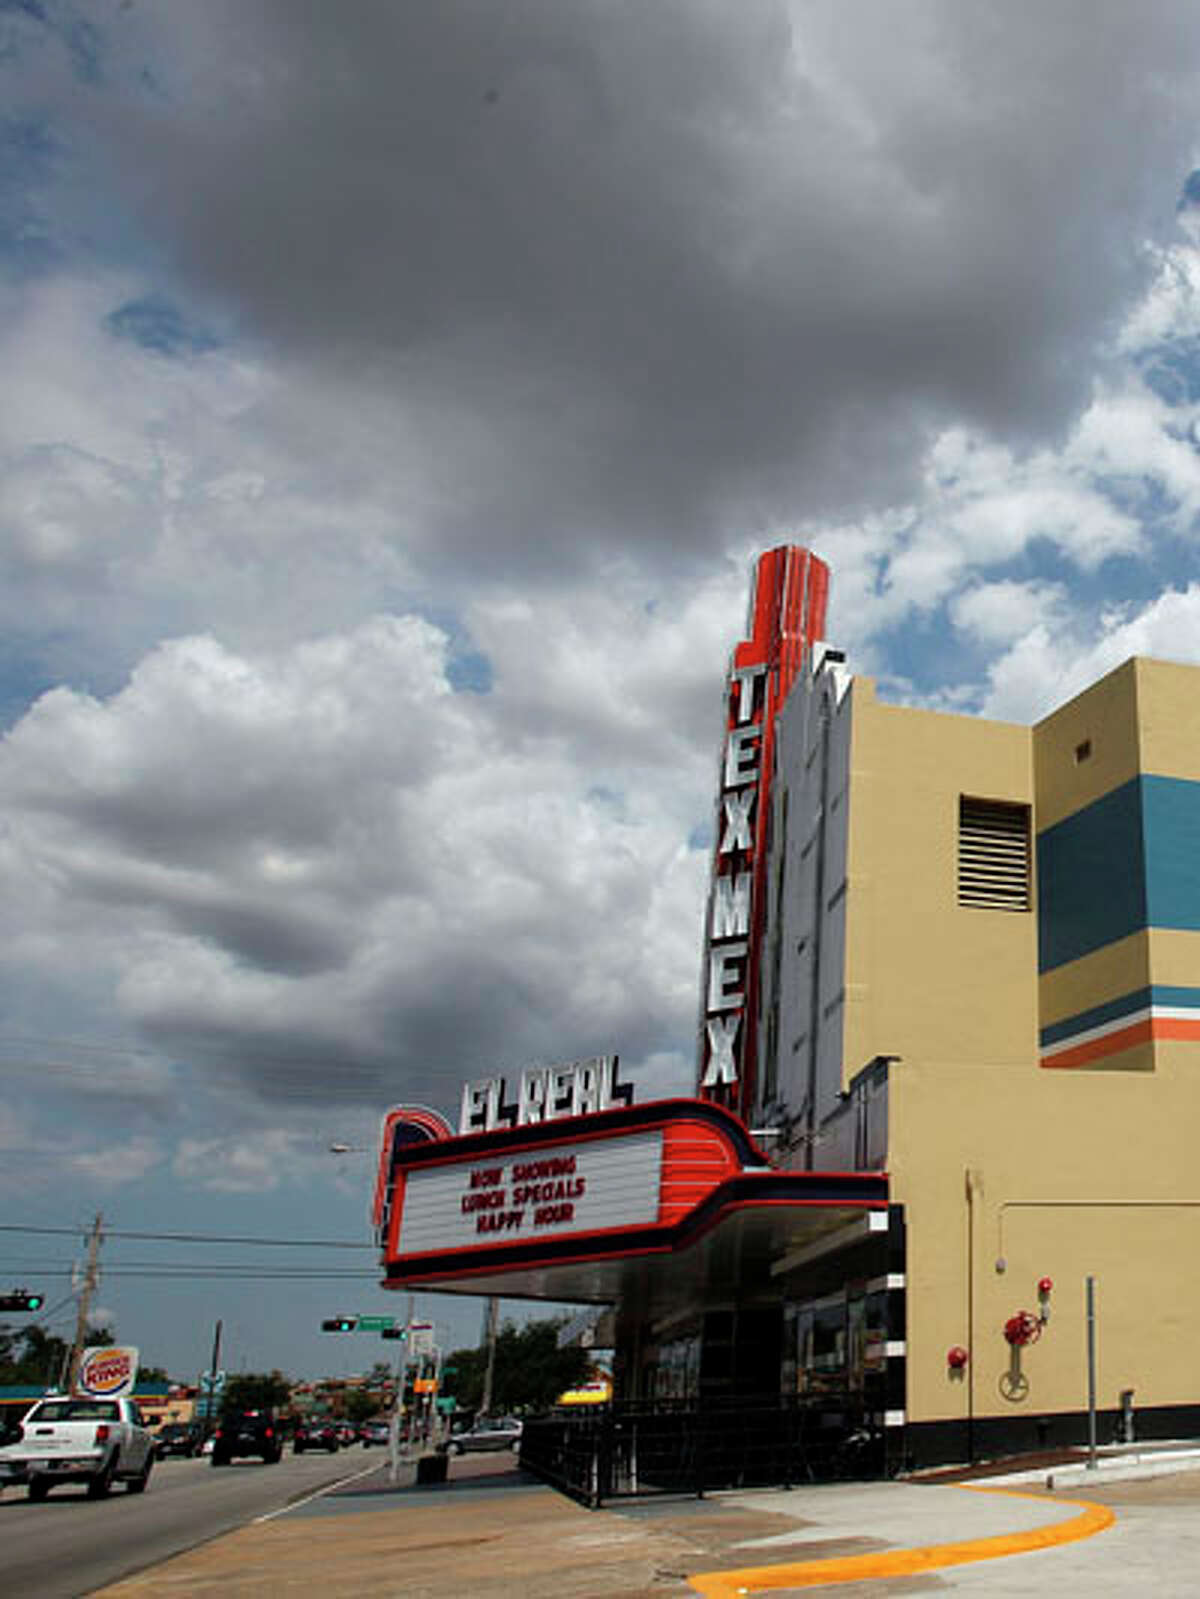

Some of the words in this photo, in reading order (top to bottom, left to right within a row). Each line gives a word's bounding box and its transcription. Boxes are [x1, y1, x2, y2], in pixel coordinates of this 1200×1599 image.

[459, 1078, 518, 1134] EL
[518, 1055, 635, 1126] REAL
[469, 1167, 504, 1190] NOW
[512, 1177, 586, 1206] SPECIALS
[476, 1210, 524, 1233] HAPPY
[534, 1202, 575, 1226] HOUR
[86, 1364, 130, 1385] KING
